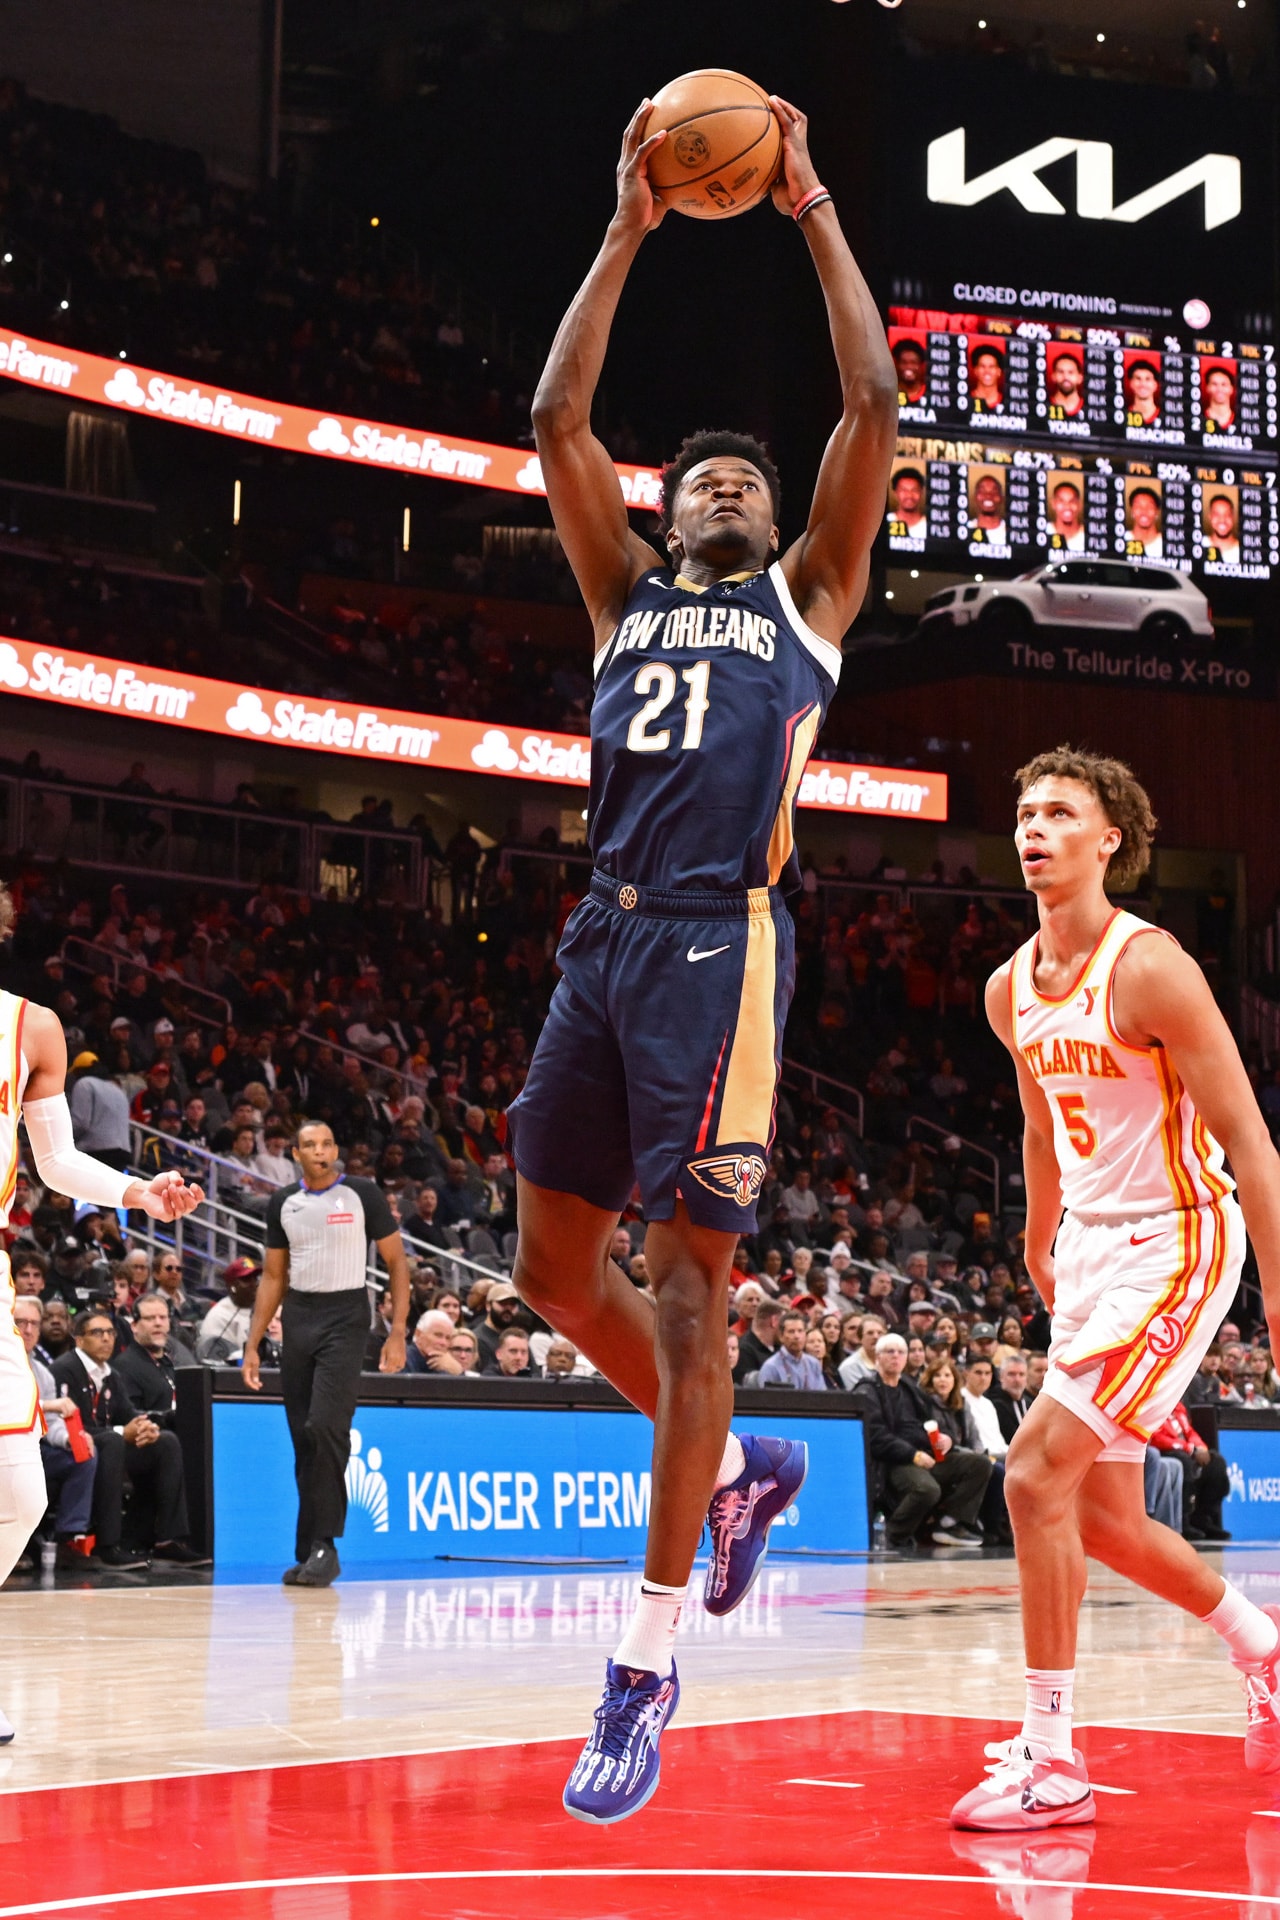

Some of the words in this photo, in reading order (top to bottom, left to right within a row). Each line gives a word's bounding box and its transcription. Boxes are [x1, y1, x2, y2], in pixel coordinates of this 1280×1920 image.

[953, 282, 1017, 305] CLOSED
[1019, 290, 1117, 315] CAPTIONING
[1016, 321, 1051, 341] 40%
[1086, 328, 1121, 347] 50%
[1221, 341, 1233, 358] 2
[1263, 345, 1275, 362] 7
[969, 412, 1027, 431] JOHNSON
[1048, 419, 1091, 437] YOUNG
[1126, 427, 1185, 445] RISACHER
[1202, 433, 1253, 451] DANIELS
[1014, 450, 1056, 470] 66.7%
[1158, 463, 1192, 482] 50%
[1223, 468, 1235, 485] 0
[1265, 472, 1276, 488] 7
[889, 536, 926, 552] MISSI
[968, 542, 1012, 560] GREEN
[1204, 562, 1270, 579] MCCOLLUM
[661, 606, 777, 662] ORLEANS
[1007, 642, 1055, 670] The
[1062, 647, 1173, 681] Telluride
[1180, 658, 1251, 688] X-Pro
[626, 660, 711, 752] 21
[1022, 1038, 1128, 1080] TLANTA
[1055, 1093, 1099, 1161] 5
[408, 1470, 541, 1532] KAISER
[1248, 1477, 1280, 1503] KAISE
